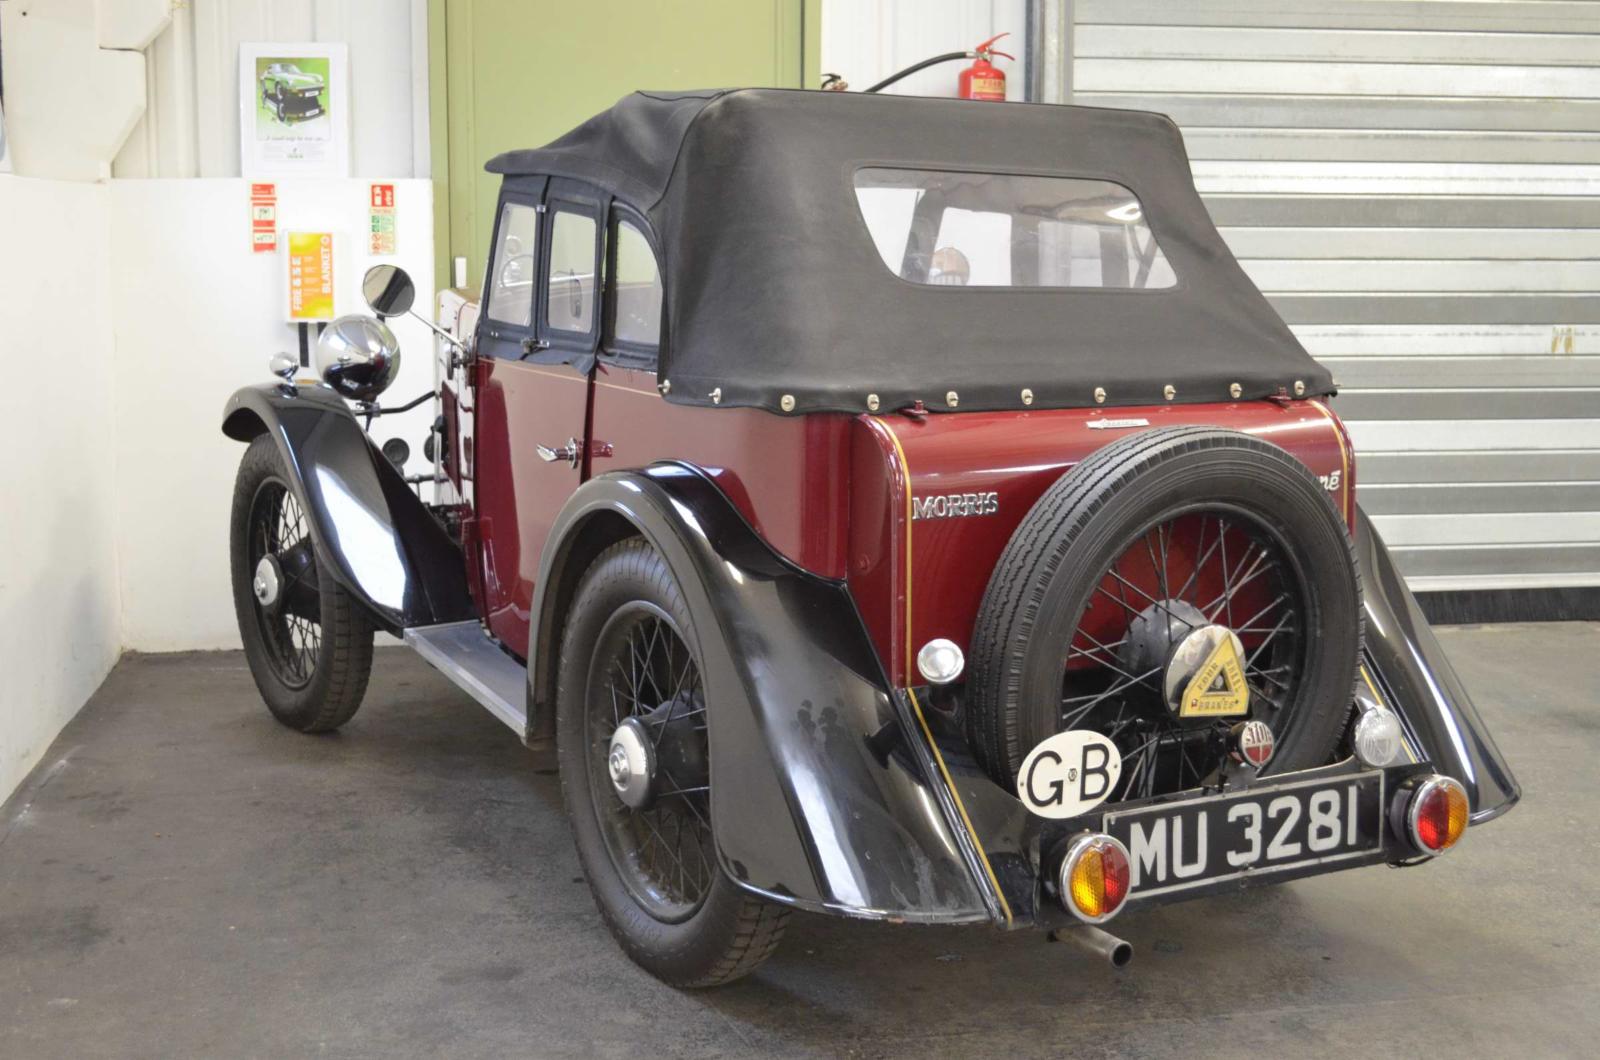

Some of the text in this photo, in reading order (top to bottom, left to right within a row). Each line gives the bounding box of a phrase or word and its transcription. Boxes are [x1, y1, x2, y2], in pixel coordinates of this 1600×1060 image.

[911, 491, 998, 520] MORRIS
[1130, 785, 1358, 888] MU 3281
